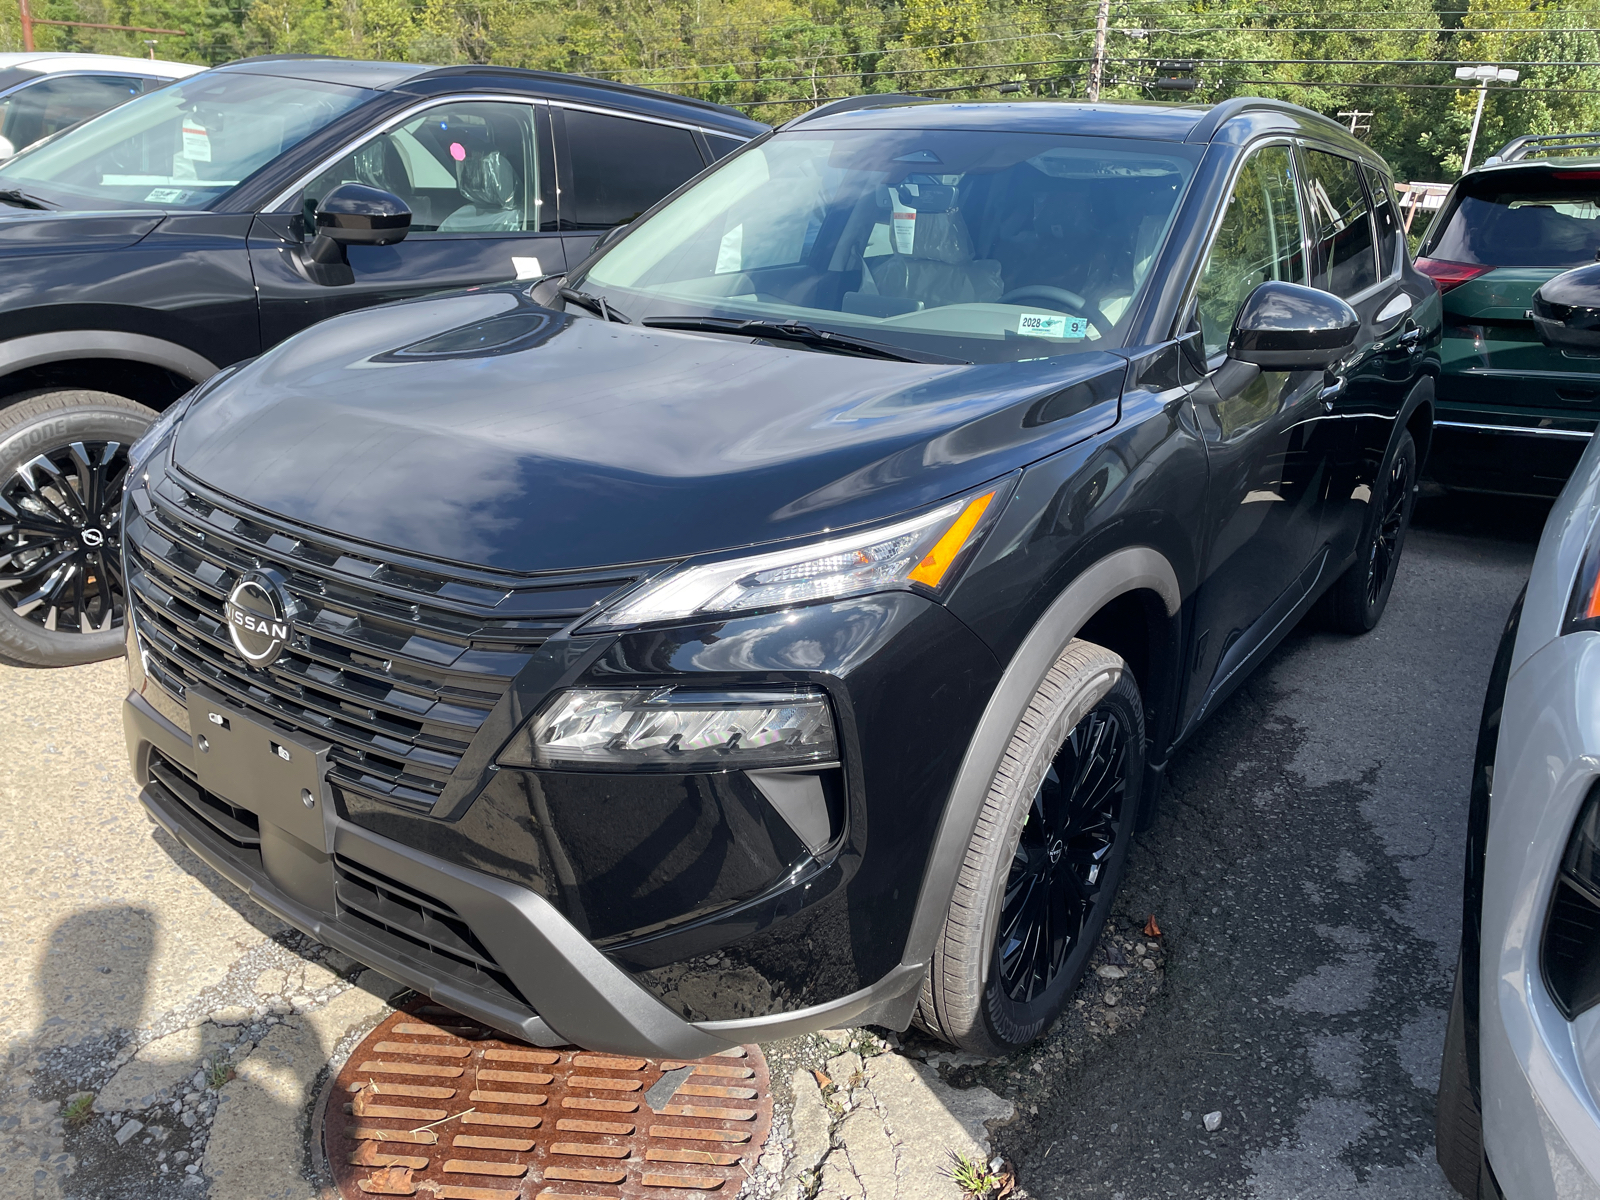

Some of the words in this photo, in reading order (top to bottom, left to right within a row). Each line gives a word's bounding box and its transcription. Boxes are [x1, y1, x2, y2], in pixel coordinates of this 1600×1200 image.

[1022, 316, 1041, 328] 2028
[1071, 322, 1079, 333] 9
[0, 419, 66, 469] ESTONE
[225, 602, 287, 640] NISSAN
